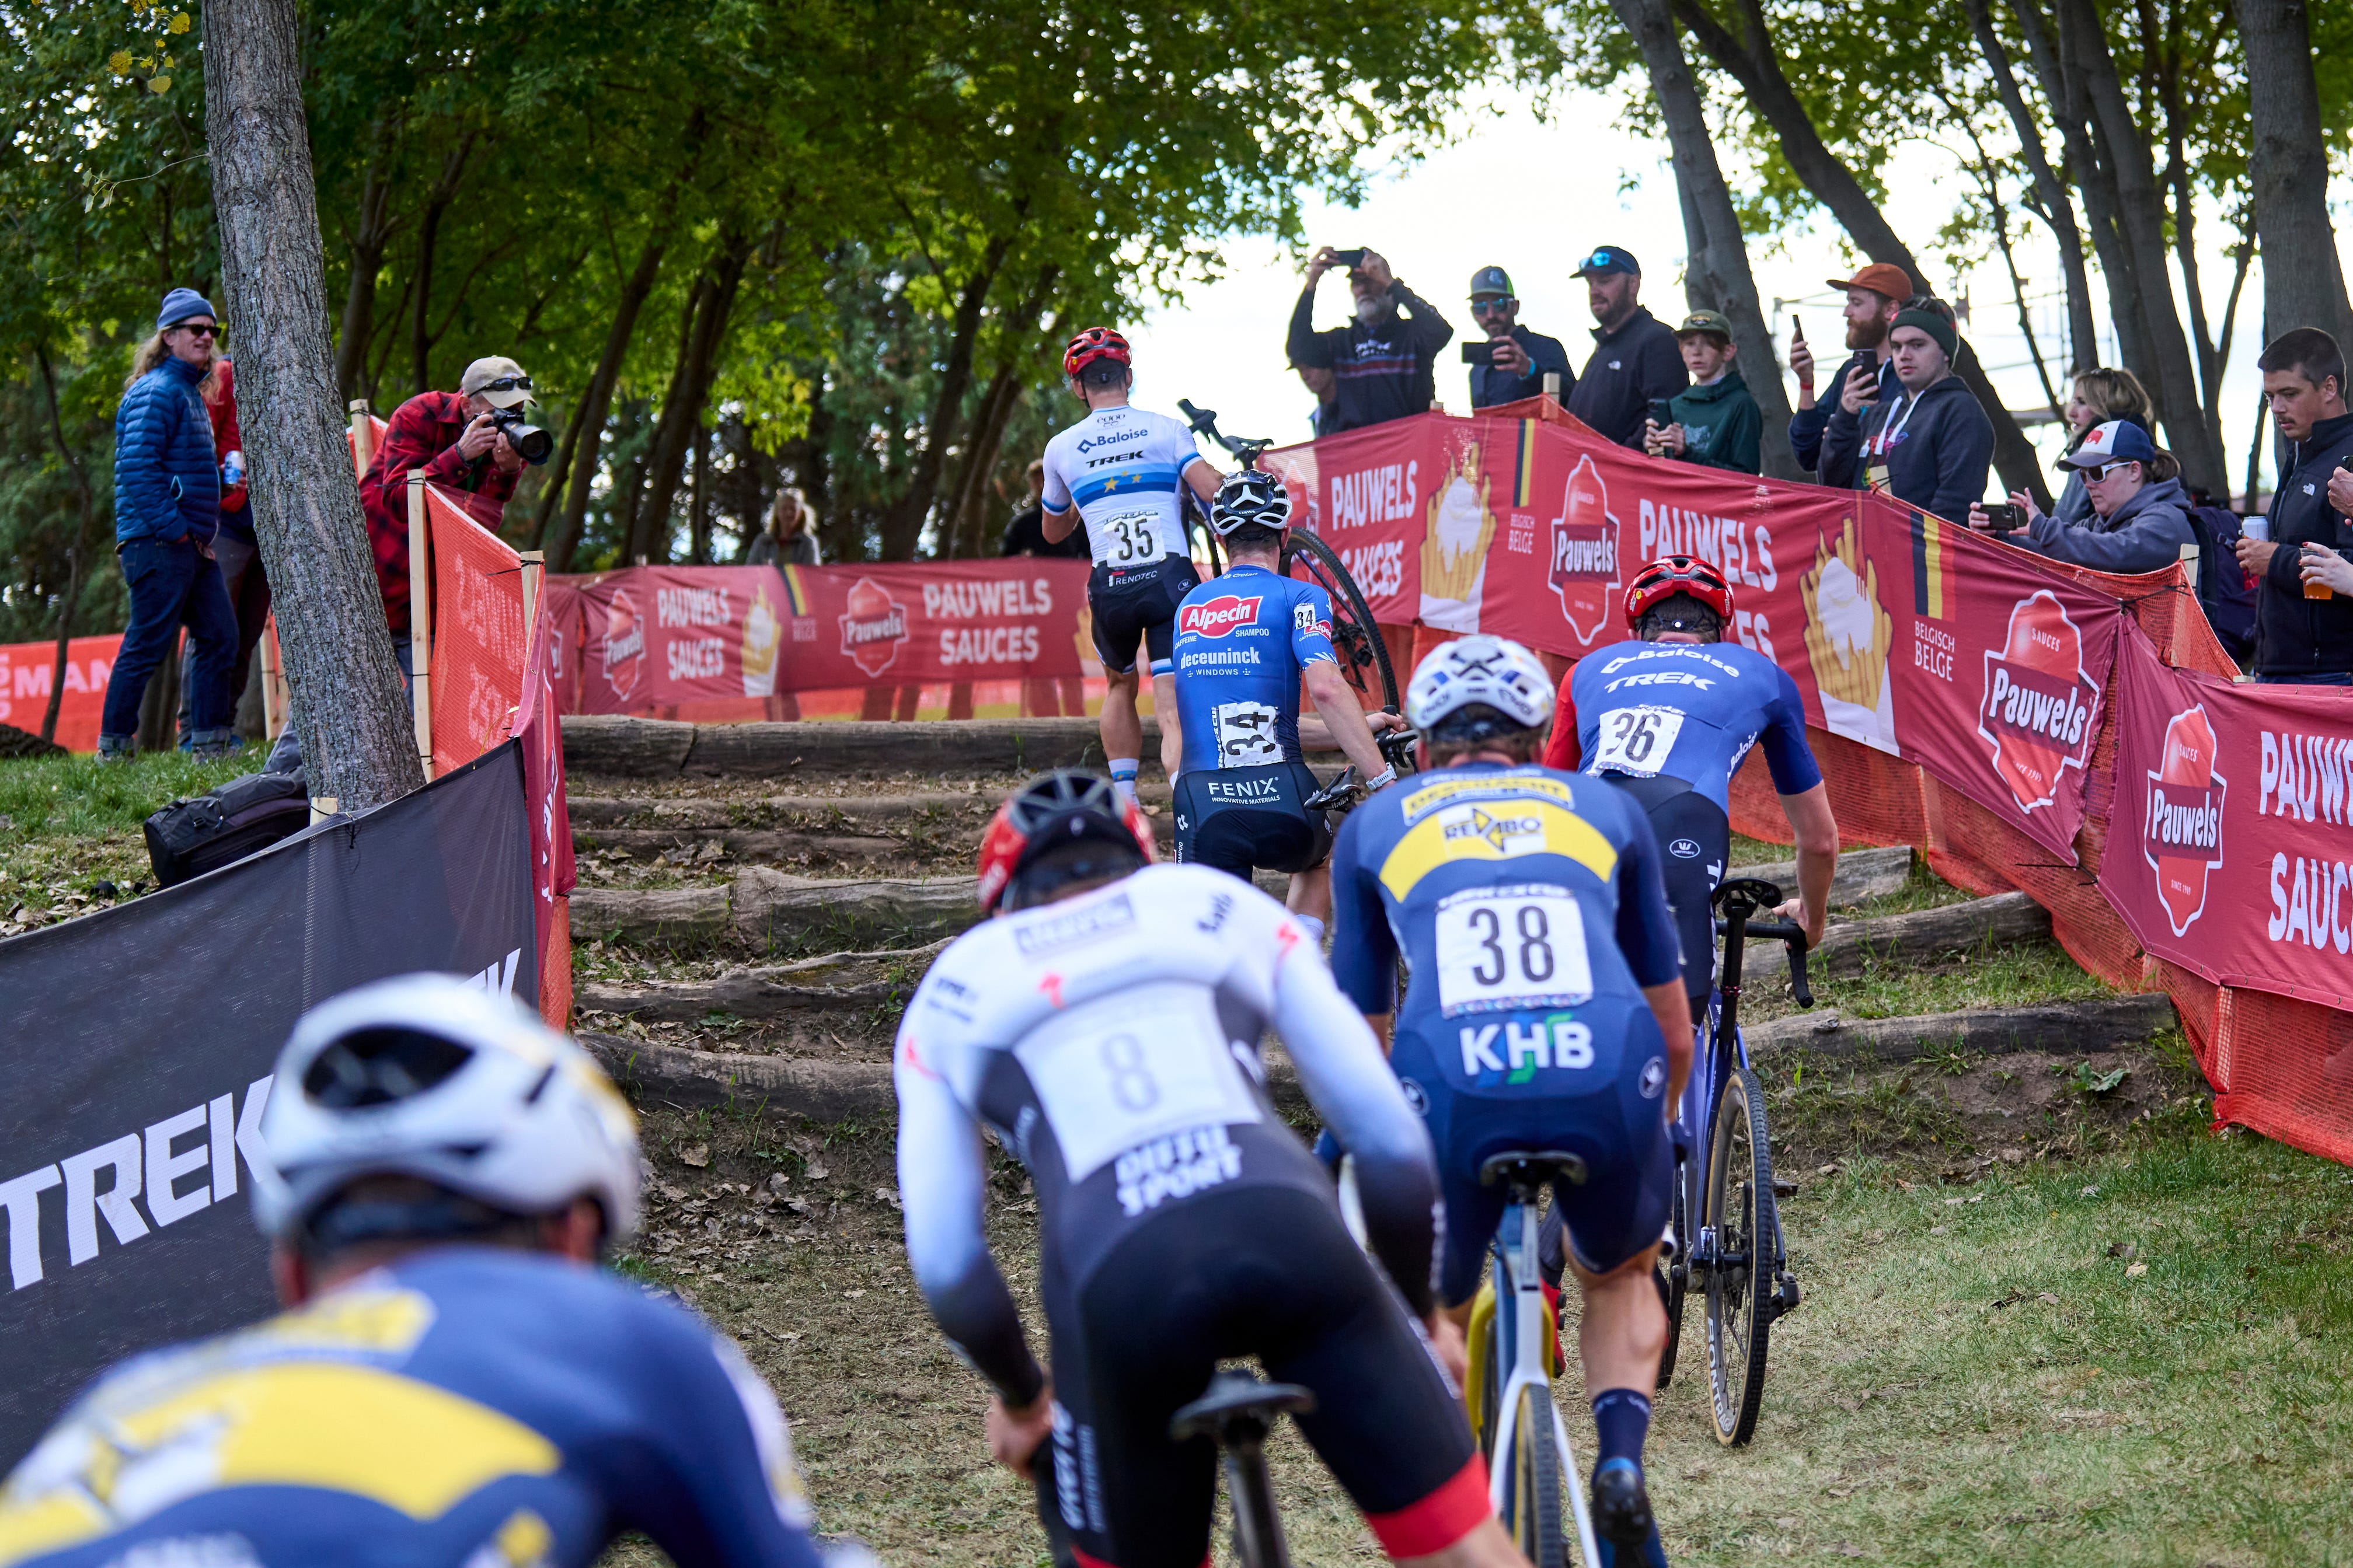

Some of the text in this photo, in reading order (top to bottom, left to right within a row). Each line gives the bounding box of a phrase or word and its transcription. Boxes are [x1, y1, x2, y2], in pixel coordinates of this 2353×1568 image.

[1097, 429, 1148, 446] Baloise
[1086, 451, 1144, 467] TREK
[1331, 460, 1417, 531] PAUWELS
[1114, 518, 1153, 561] 35
[1556, 528, 1613, 572] Pauwels
[1640, 498, 1777, 592] PAUWELS
[1116, 570, 1158, 585] RENOTEC
[658, 588, 731, 628] PAUWELS
[923, 578, 1051, 619] PAUWELS
[1186, 603, 1251, 630] Alpecin
[1174, 628, 1269, 649] CAFFEINE SHAMPOO
[1297, 610, 1313, 628] 34
[1299, 633, 1319, 642] CAFFEINE
[1915, 620, 1955, 653] BELGISCH
[668, 638, 724, 682] SAUCES
[940, 626, 1039, 666] SAUCES
[1180, 647, 1261, 669] deceuninck
[2032, 628, 2061, 652] SAUCES
[1637, 648, 1740, 678] Baloise
[1915, 640, 1953, 682] BELGE
[1605, 672, 1716, 693] TREK
[1989, 668, 2086, 745] Pauwels
[1225, 712, 1275, 755] 34
[1606, 713, 1661, 763] 36
[2179, 743, 2198, 763] SAUCES
[1249, 795, 1280, 805] MATERIALS
[2152, 789, 2217, 848] Pauwels
[2171, 879, 2191, 896] SINCE 1909
[2268, 852, 2353, 955] SAUC
[1469, 906, 1553, 985] 38
[1460, 1021, 1595, 1075] KHB
[1100, 1032, 1158, 1113] 8
[0, 1074, 276, 1291] TREK
